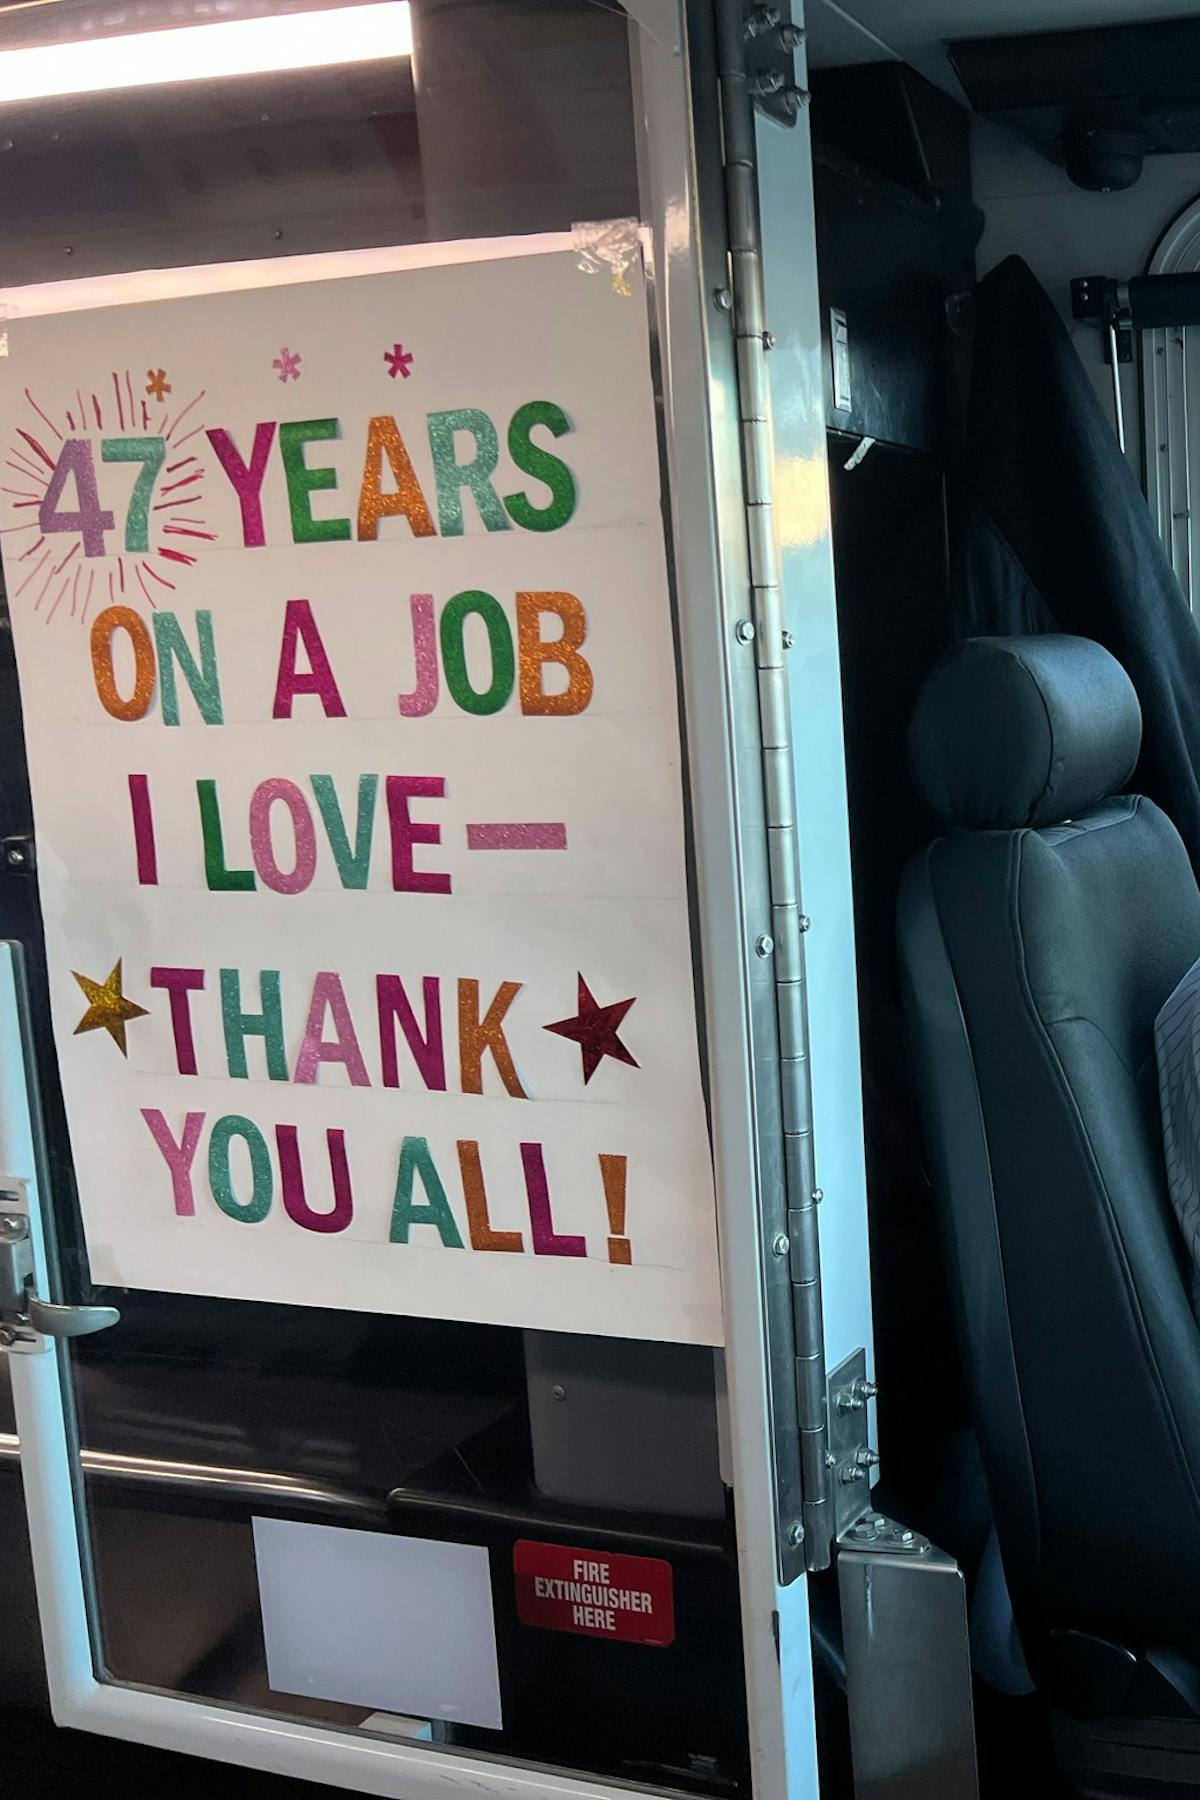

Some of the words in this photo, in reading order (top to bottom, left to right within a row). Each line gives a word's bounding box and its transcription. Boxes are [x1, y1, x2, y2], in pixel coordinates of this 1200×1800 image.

[38, 436, 165, 557] 47
[205, 401, 578, 547] YEARS
[90, 606, 224, 727] ON
[273, 600, 347, 719] A
[398, 590, 594, 717] JOB
[128, 775, 158, 885] I
[150, 967, 529, 1099] THANK
[139, 1108, 354, 1234] YOU
[388, 1136, 633, 1266] ALL!
[534, 1576, 653, 1614] EXTINGUISHER
[573, 1559, 610, 1585] FIRE
[573, 1605, 616, 1631] HERE
